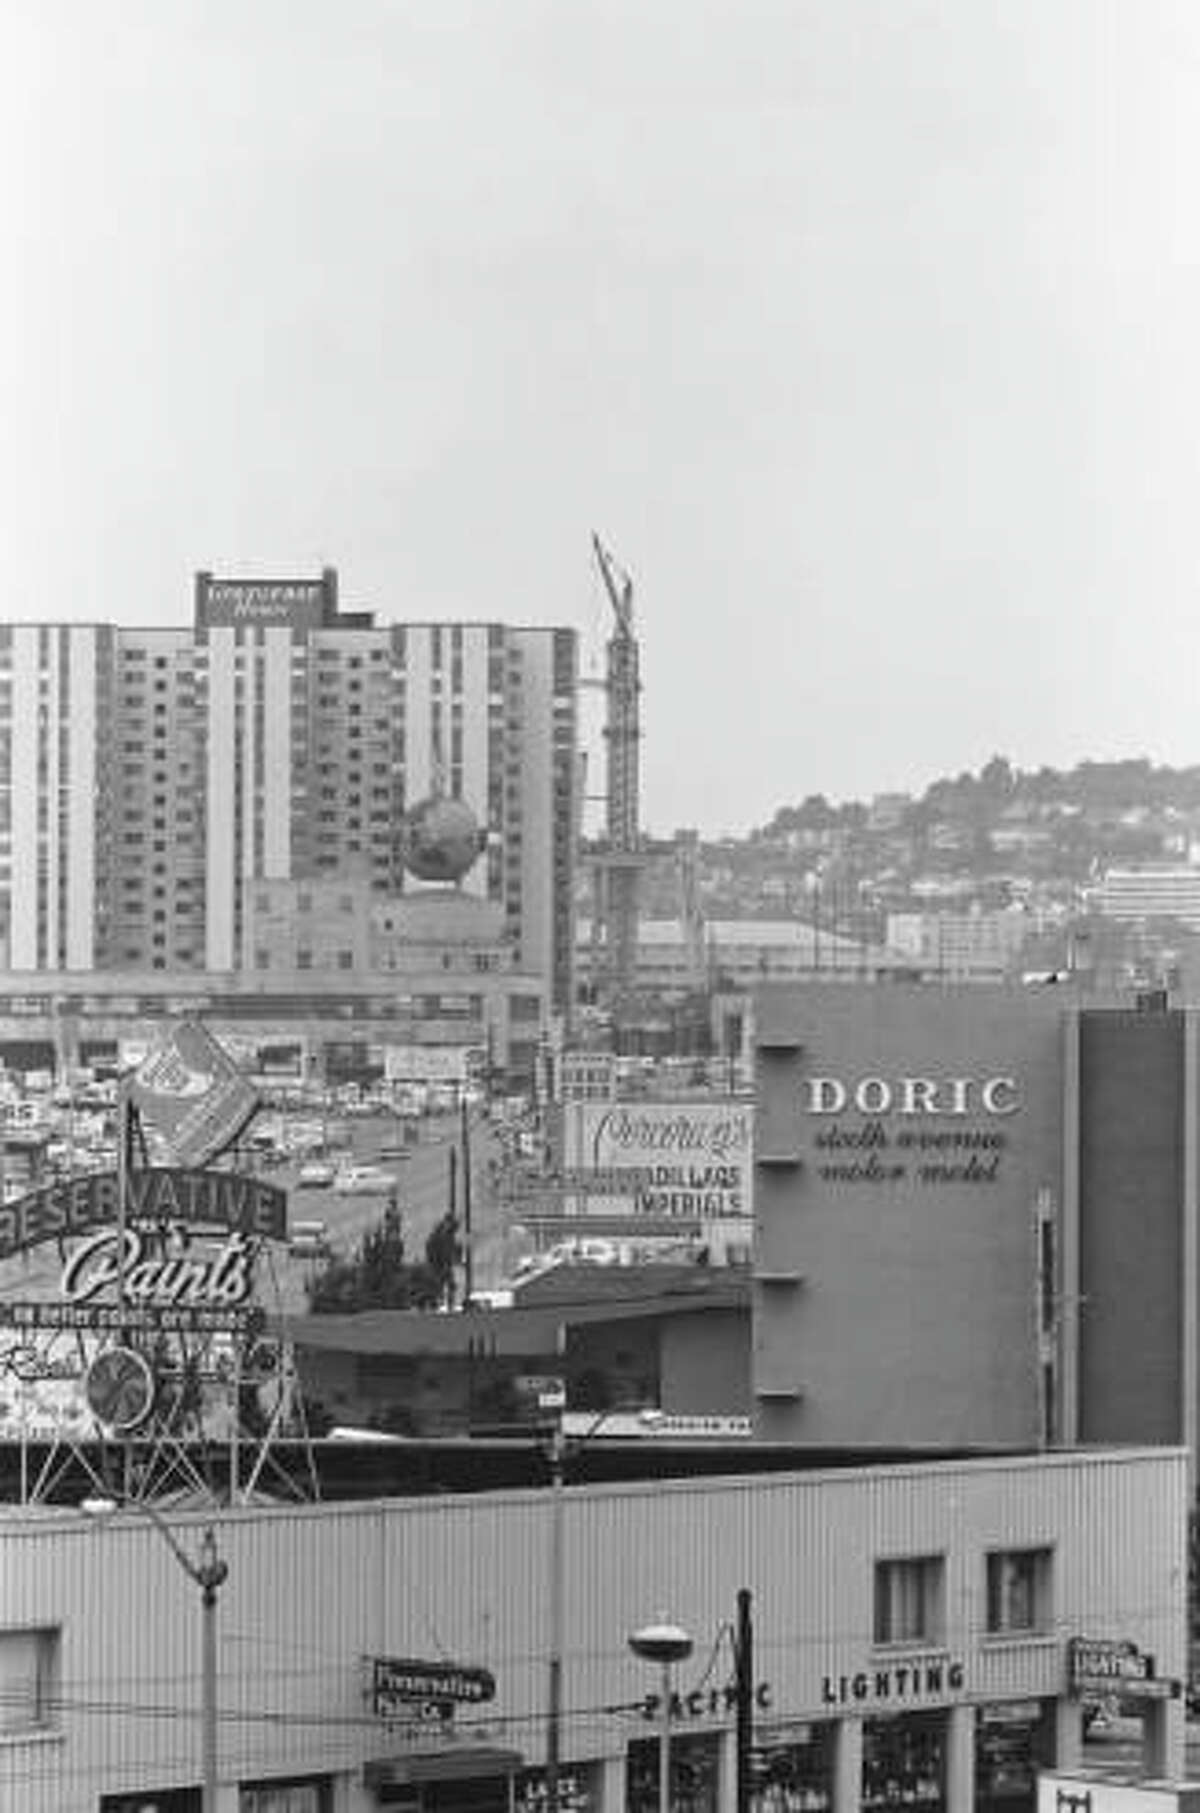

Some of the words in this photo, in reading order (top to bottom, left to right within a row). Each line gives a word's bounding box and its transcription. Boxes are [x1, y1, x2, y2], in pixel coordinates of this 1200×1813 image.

[805, 1077, 1019, 1115] DORIC
[61, 1228, 252, 1301] Paints
[640, 1681, 771, 1721] PACIFC
[821, 1662, 965, 1704] LIGHTING
